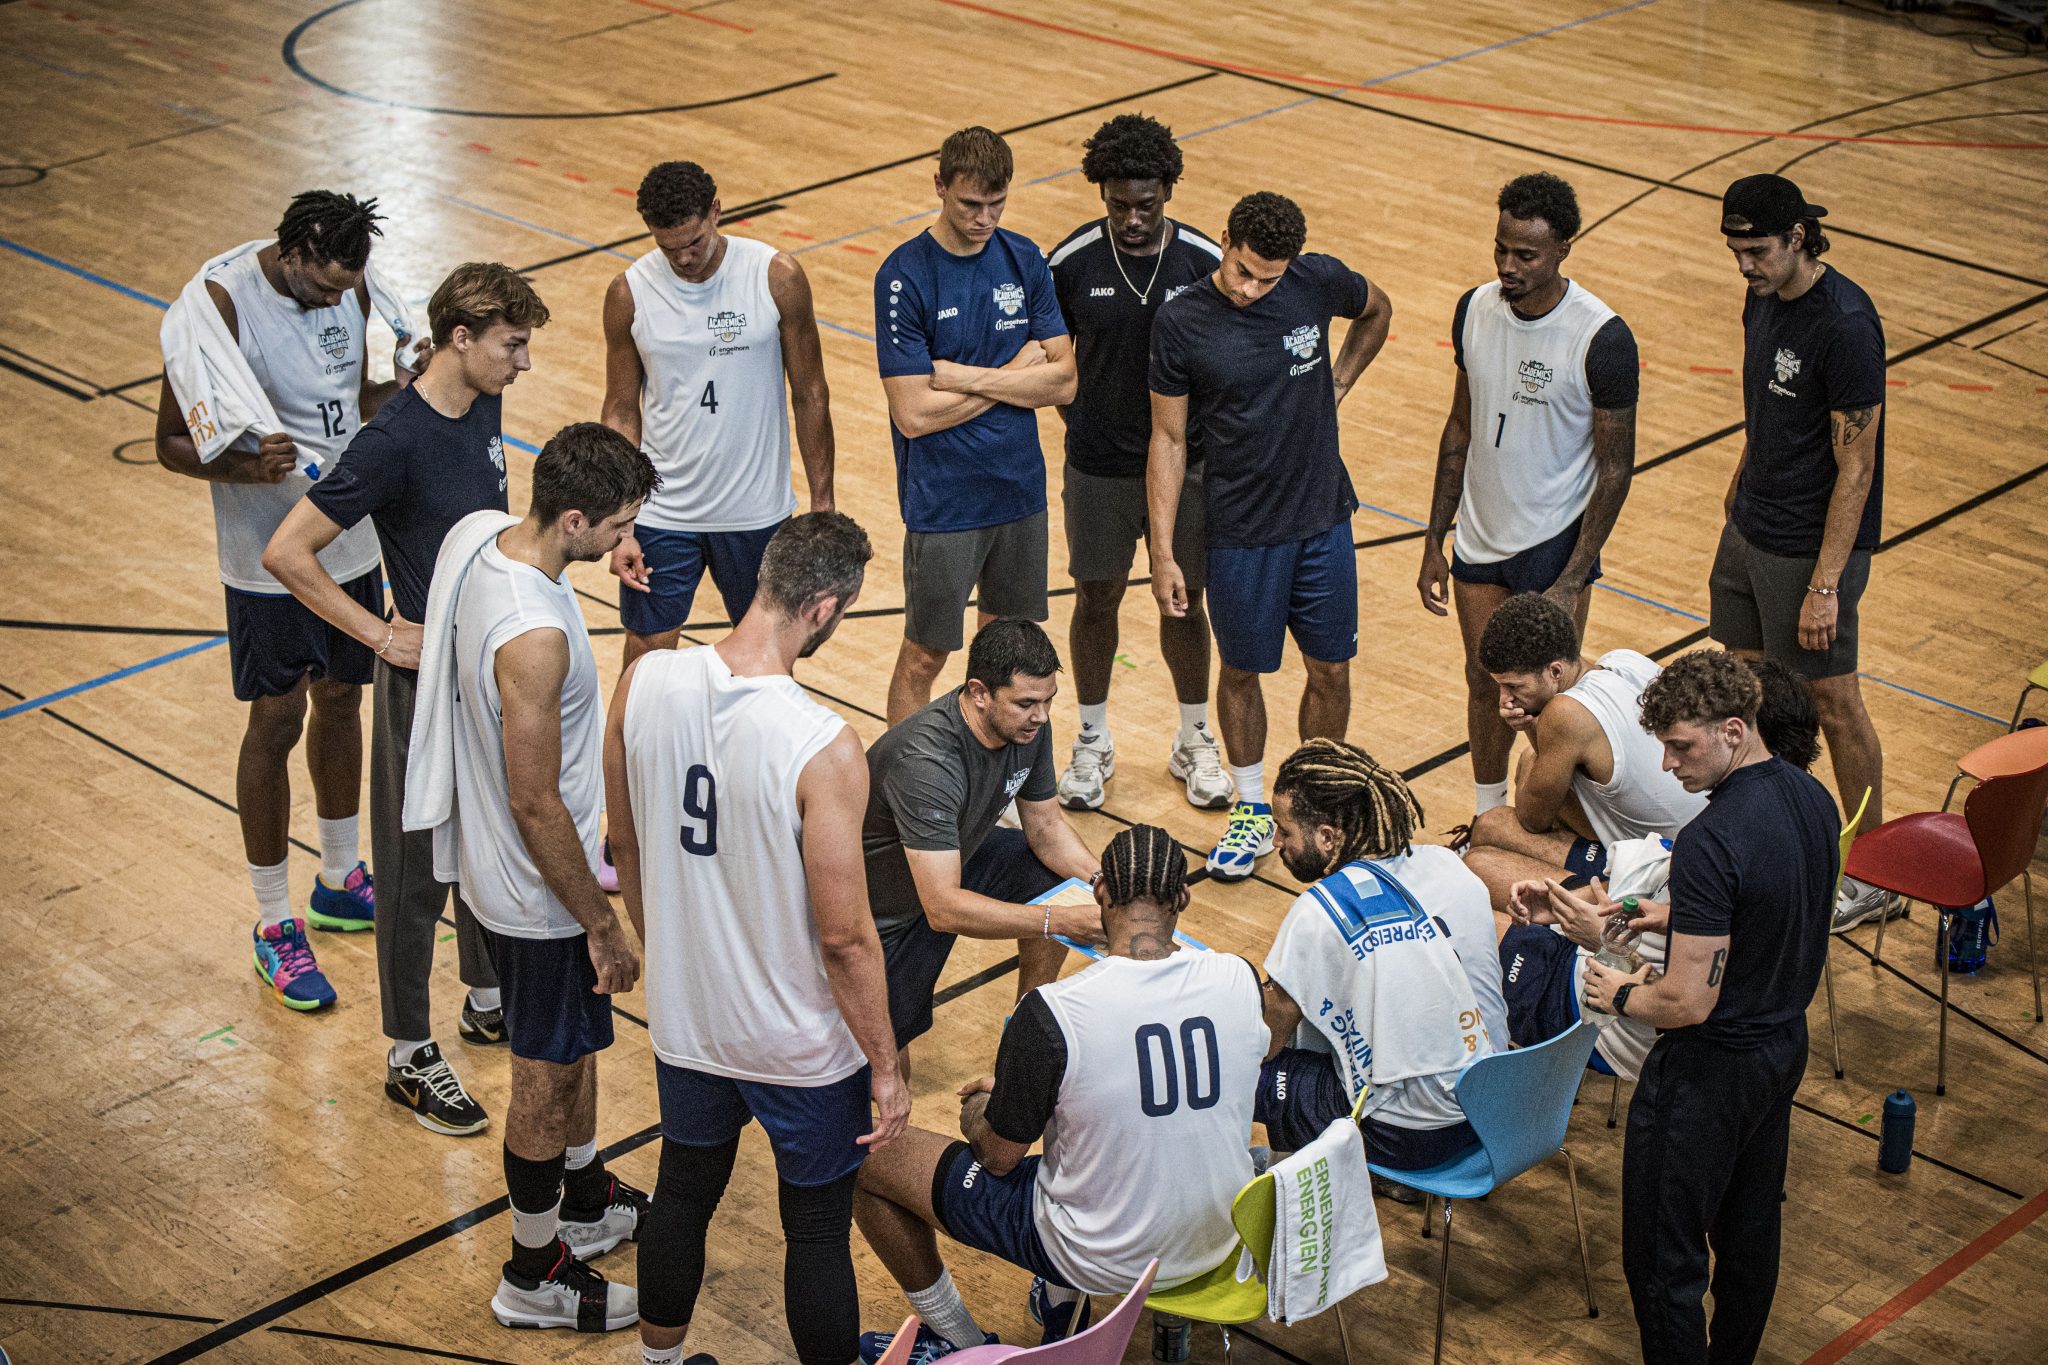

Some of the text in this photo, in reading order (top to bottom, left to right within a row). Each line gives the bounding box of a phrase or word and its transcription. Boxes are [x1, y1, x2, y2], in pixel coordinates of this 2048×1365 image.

[1090, 287, 1115, 297] JAKO
[708, 314, 747, 330] ACADEMICS
[937, 307, 959, 321] JAKO
[1519, 361, 1553, 382] ACADEMICS
[700, 380, 719, 414] 4
[316, 399, 346, 438] 12
[1494, 412, 1506, 448] 1
[680, 763, 718, 857] 9
[1508, 953, 1525, 983] JAKO
[1319, 997, 1334, 1017] &
[1462, 1033, 1477, 1052] &
[1135, 1015, 1221, 1118] 00
[1276, 1070, 1287, 1100] JAKO
[962, 1161, 982, 1189] JAKO
[1296, 1166, 1318, 1275] ENERGIEN
